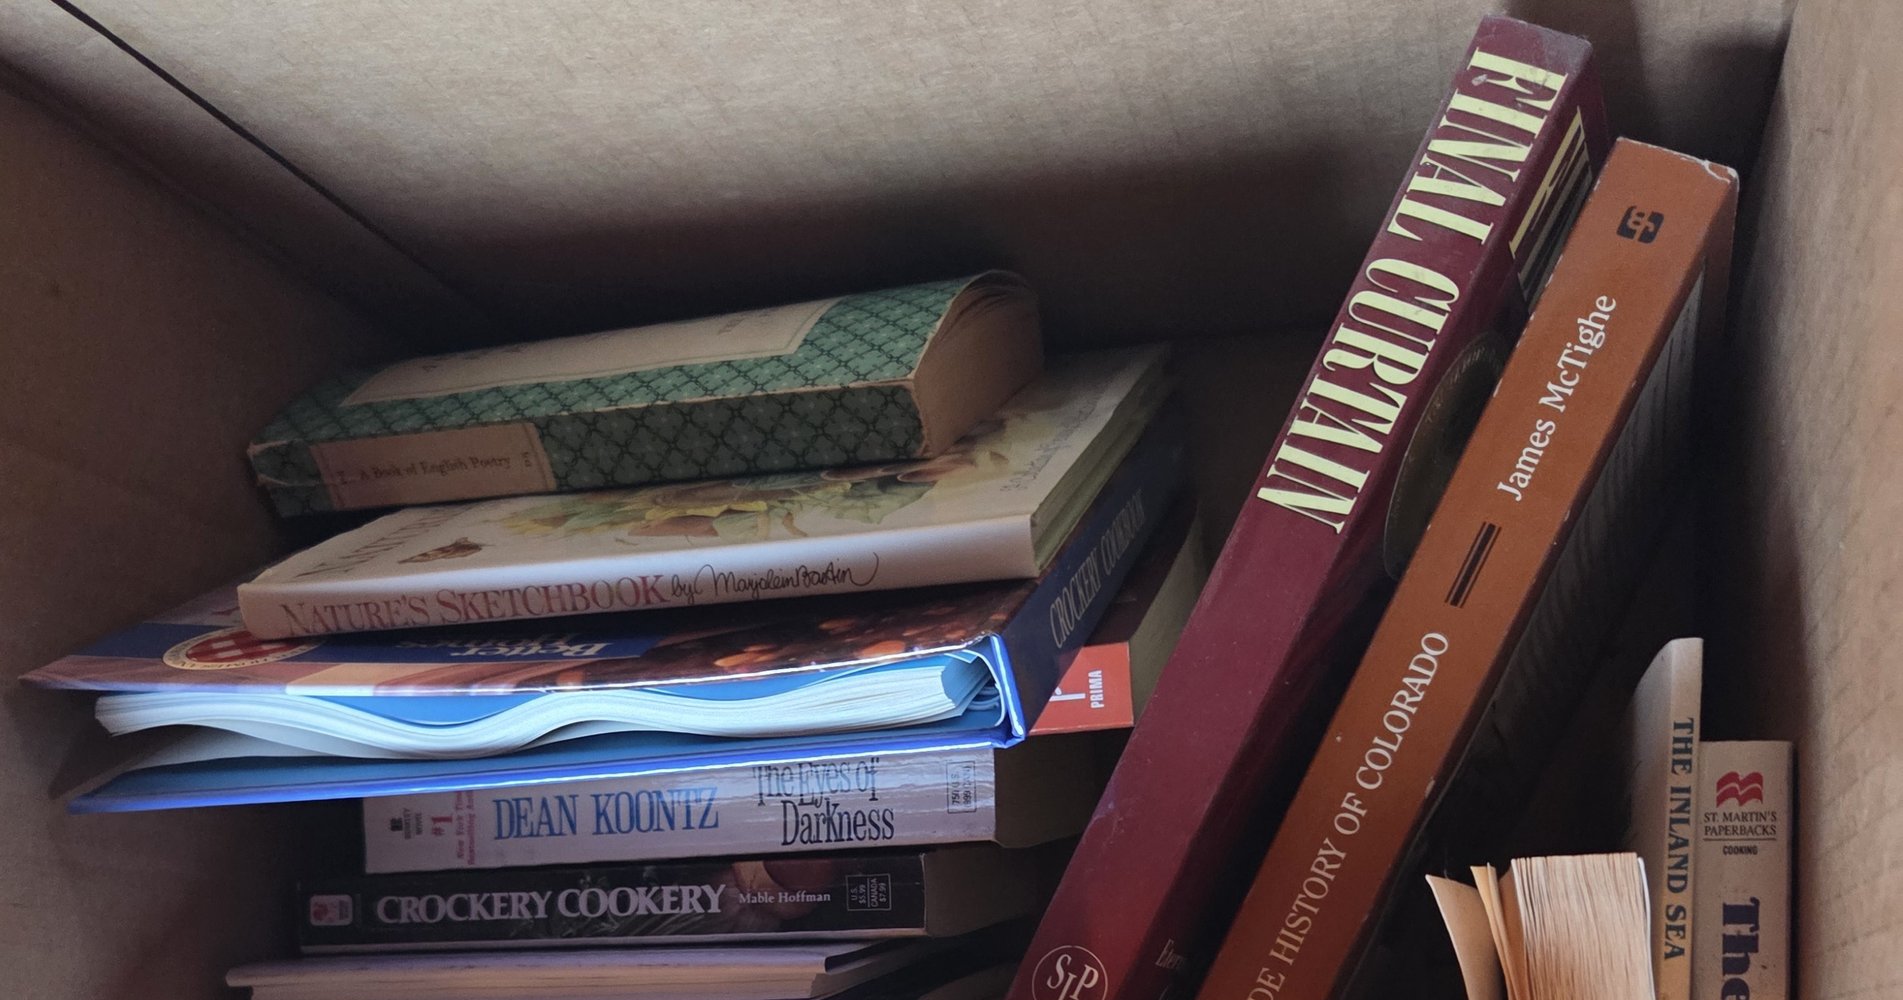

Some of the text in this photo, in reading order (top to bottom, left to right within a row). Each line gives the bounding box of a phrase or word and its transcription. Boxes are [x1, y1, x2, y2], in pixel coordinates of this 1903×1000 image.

[1386, 47, 1569, 245] FINAL
[1257, 257, 1461, 536] CURTAIN
[1496, 418, 1557, 502] James
[1538, 294, 1617, 413] McTighe
[278, 596, 430, 637] NATURE'S
[438, 575, 668, 624] SKETCHBOOK
[671, 578, 696, 602] by
[1049, 547, 1101, 649] CROCKERY
[1091, 669, 1104, 708] PRIMA
[752, 757, 880, 807] The Eyes of
[1267, 838, 1347, 968] HISTORY
[1333, 791, 1369, 837] OF
[1355, 631, 1450, 790] COLORADO
[493, 794, 577, 841] DEAN
[591, 786, 720, 836] KOONTZ
[781, 800, 895, 846] Darkness
[1664, 717, 1695, 960] THE INLAND SEA
[1703, 811, 1777, 823] ST. MARTIN'S
[1704, 825, 1777, 836] PAPERBACKS
[1722, 845, 1758, 856] COOKING
[377, 890, 551, 924] CROCKERY
[556, 884, 726, 919] COOKERY
[738, 890, 831, 904] Mable Hoffman
[870, 877, 879, 908] CANADA
